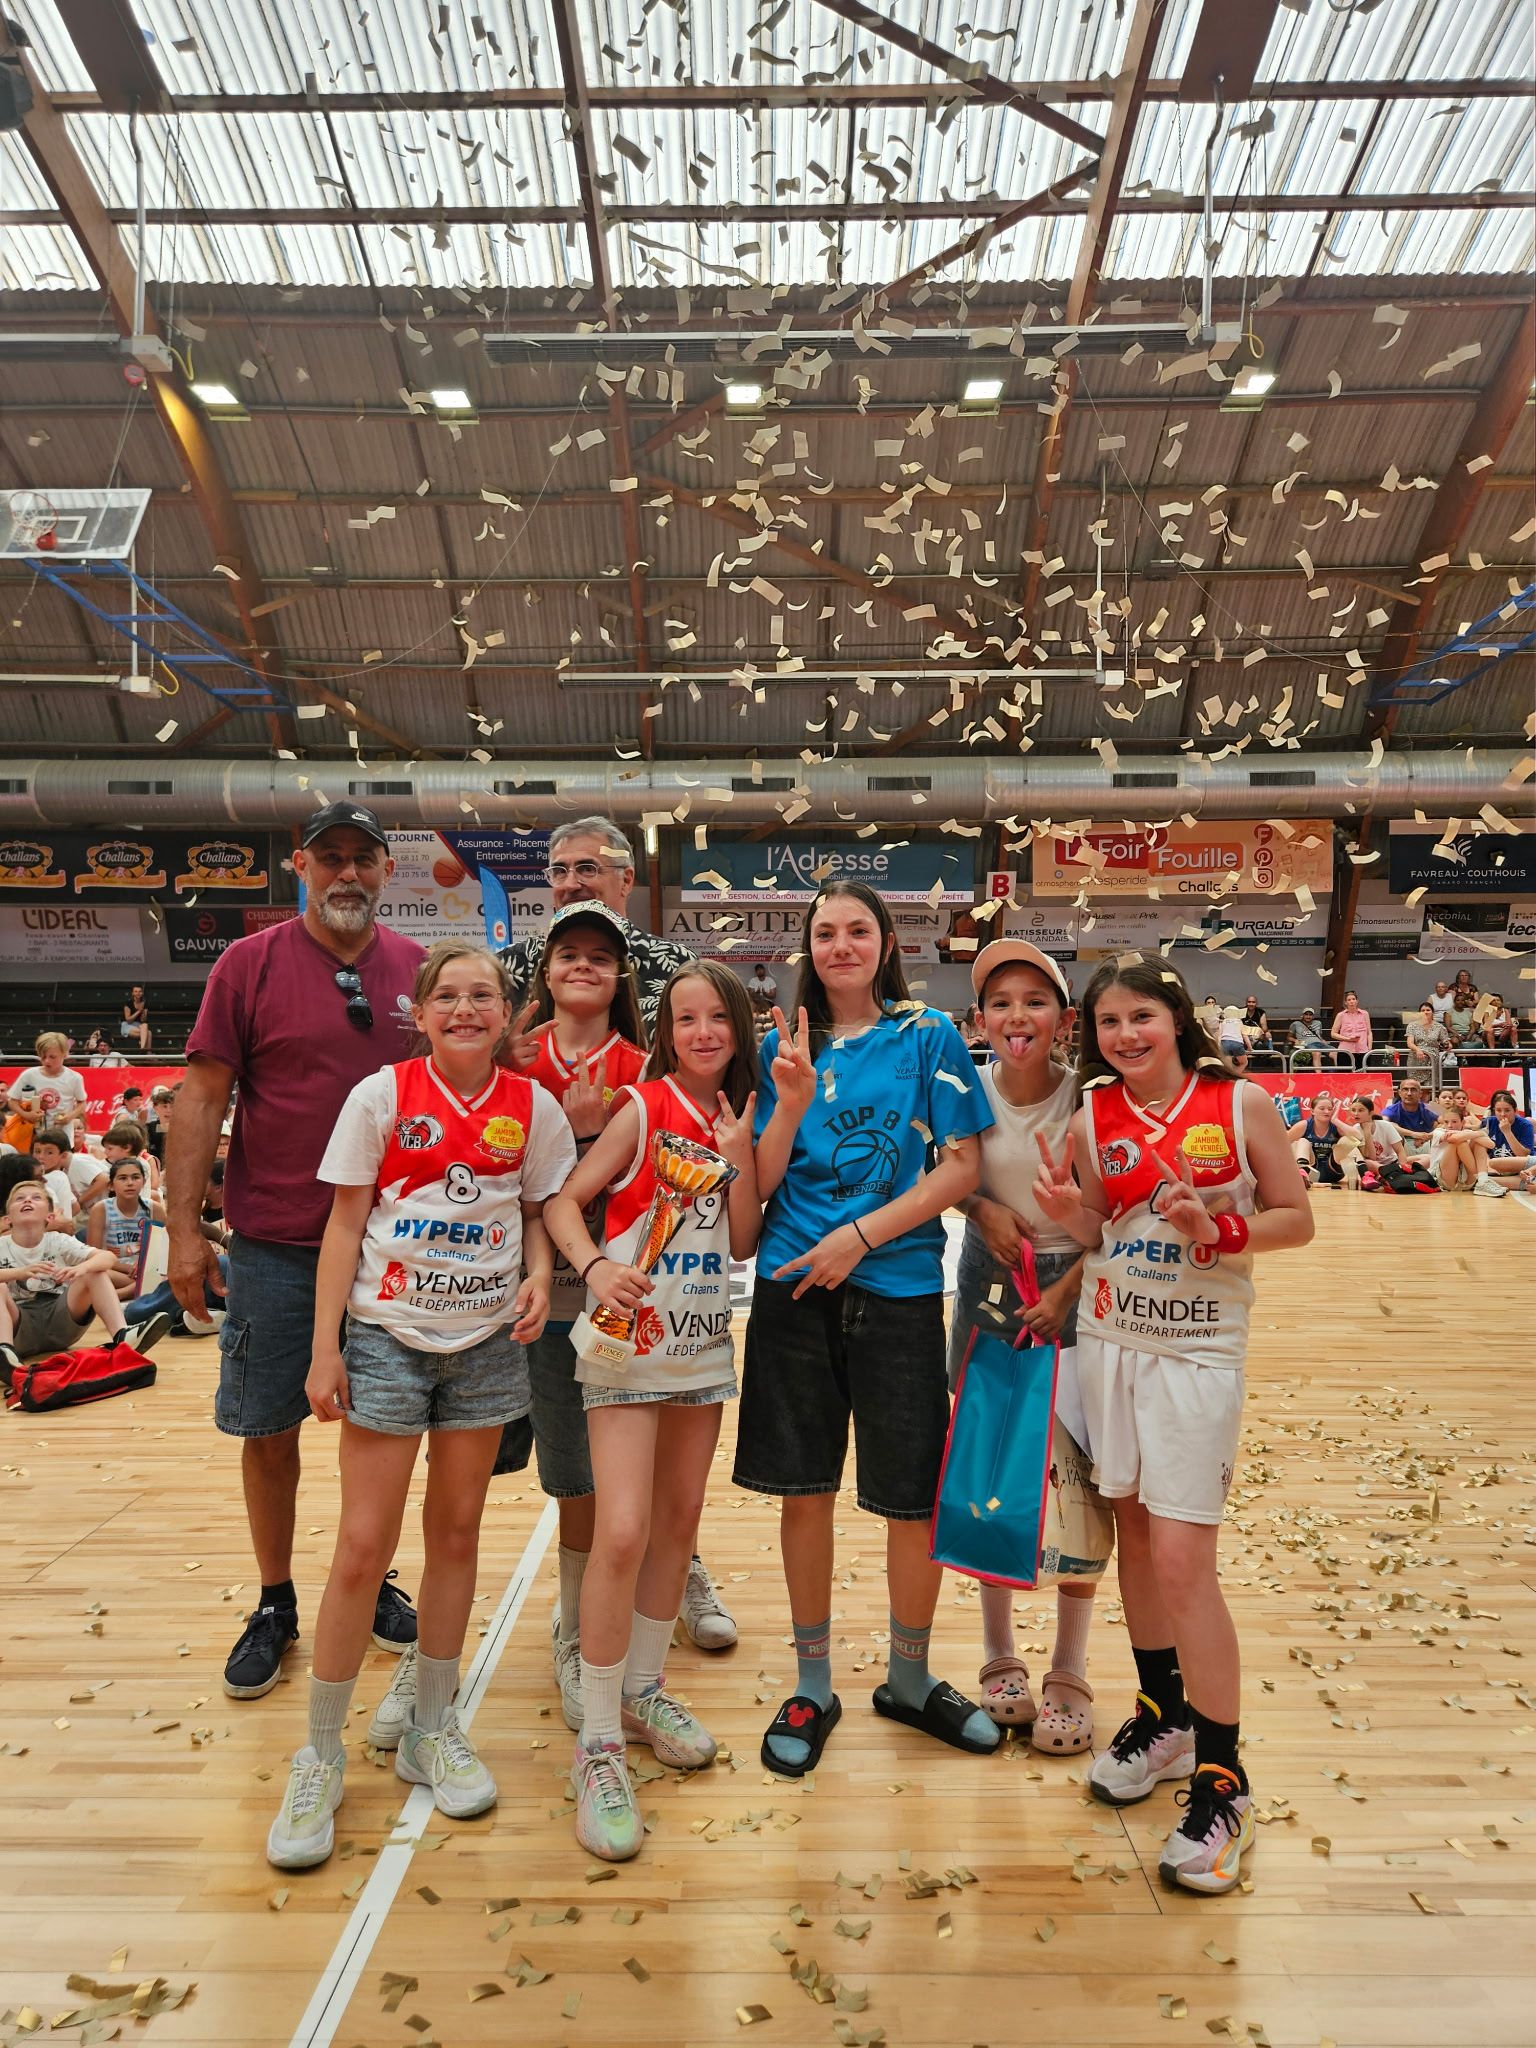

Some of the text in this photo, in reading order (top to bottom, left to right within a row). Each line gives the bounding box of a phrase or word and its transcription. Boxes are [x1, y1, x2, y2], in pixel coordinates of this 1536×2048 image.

[385, 833, 435, 842] EJOURNE
[457, 839, 504, 848] Assurance
[99, 851, 140, 863] Challans
[200, 851, 242, 864] Challans
[476, 851, 527, 861] Entreprises
[767, 844, 889, 876] l'Adresse
[1157, 847, 1238, 869] Fouille
[852, 873, 888, 881] coopératif
[1410, 870, 1459, 878] FAVREAU
[1467, 869, 1526, 877] COUTHOUIS
[991, 874, 1010, 897] B
[1178, 880, 1239, 893] Challas
[398, 898, 438, 916] mie
[22, 909, 108, 930] L'IDEAL
[822, 1106, 900, 1137] TOP 8
[494, 1127, 517, 1137] JAMBON
[399, 1134, 422, 1149] VCB
[1194, 1136, 1219, 1144] JAMBON
[489, 1147, 518, 1158] Petitgas
[1200, 1144, 1224, 1152] VENDÉE
[1103, 1160, 1121, 1176] VCB
[1190, 1157, 1225, 1167] Petitgas
[445, 1163, 481, 1204] 8
[842, 1181, 891, 1197] VENDÉE
[694, 1189, 722, 1230] 9
[392, 1219, 484, 1245] HYPER
[426, 1248, 476, 1263] Challans
[1127, 1265, 1178, 1282] Challans
[414, 1270, 508, 1294] VENDÉE
[409, 1293, 505, 1311] LE DÉPARTEMEN
[1116, 1286, 1220, 1322] VENDÉE
[1115, 1318, 1220, 1338] LE DÉPARTEMENT
[666, 1345, 679, 1355] LE
